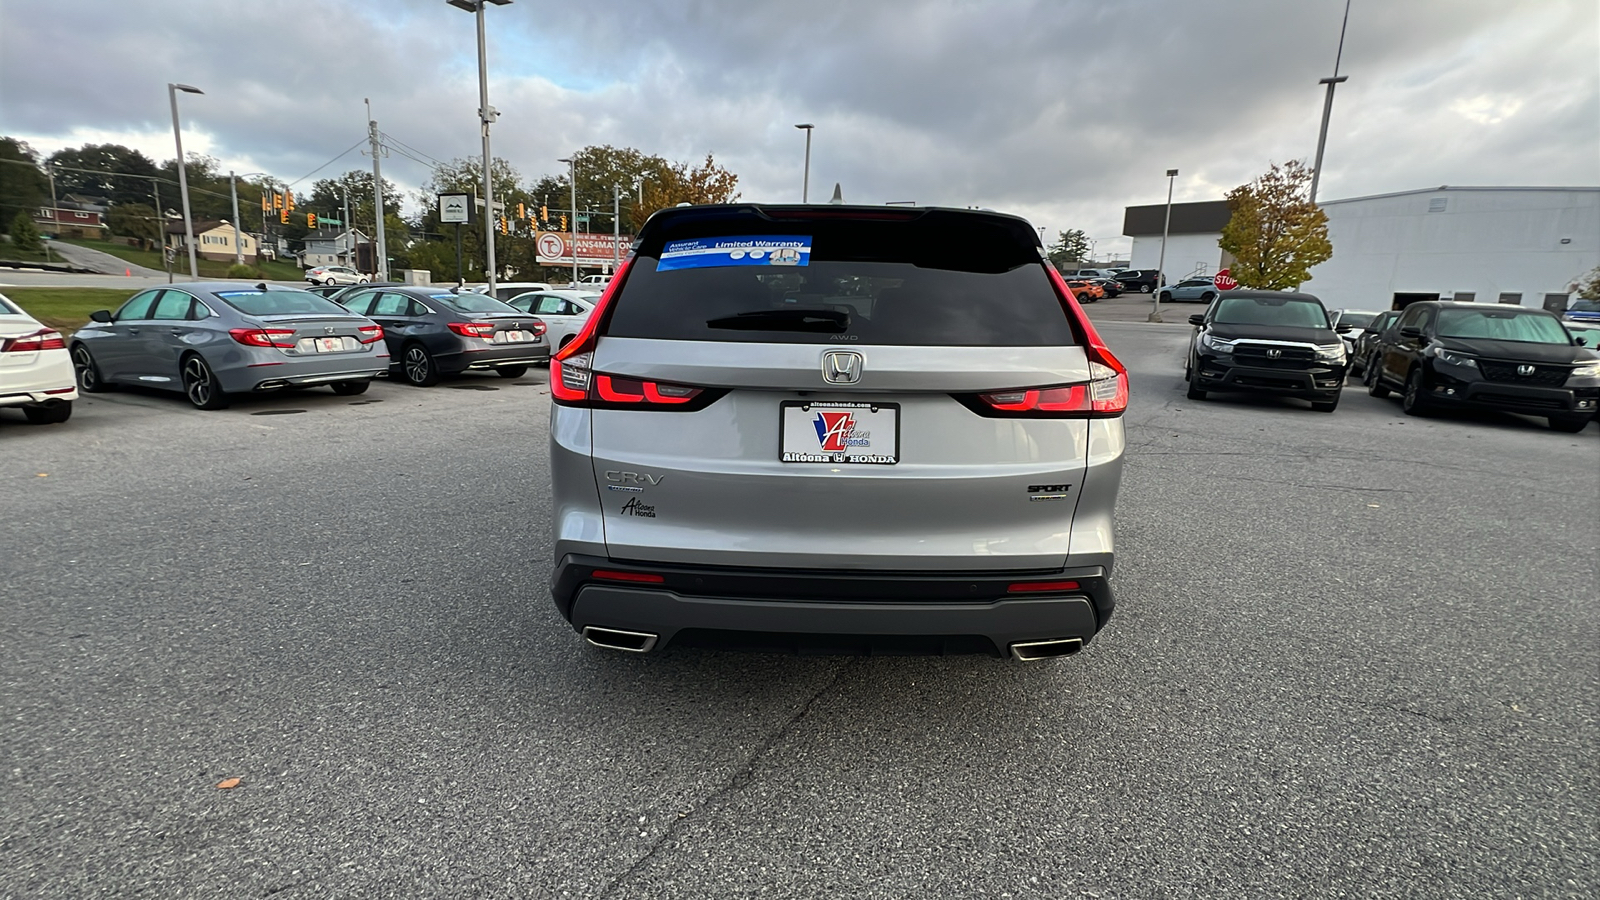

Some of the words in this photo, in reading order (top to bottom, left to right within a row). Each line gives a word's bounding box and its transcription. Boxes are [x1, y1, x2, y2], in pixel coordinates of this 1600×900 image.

[755, 240, 804, 248] Warranty
[841, 437, 870, 447] Honda
[782, 452, 830, 462] Altoona
[849, 455, 896, 463] HONDA
[605, 470, 664, 486] CR-V
[1027, 484, 1072, 493] SPORT
[635, 510, 656, 518] Honda
